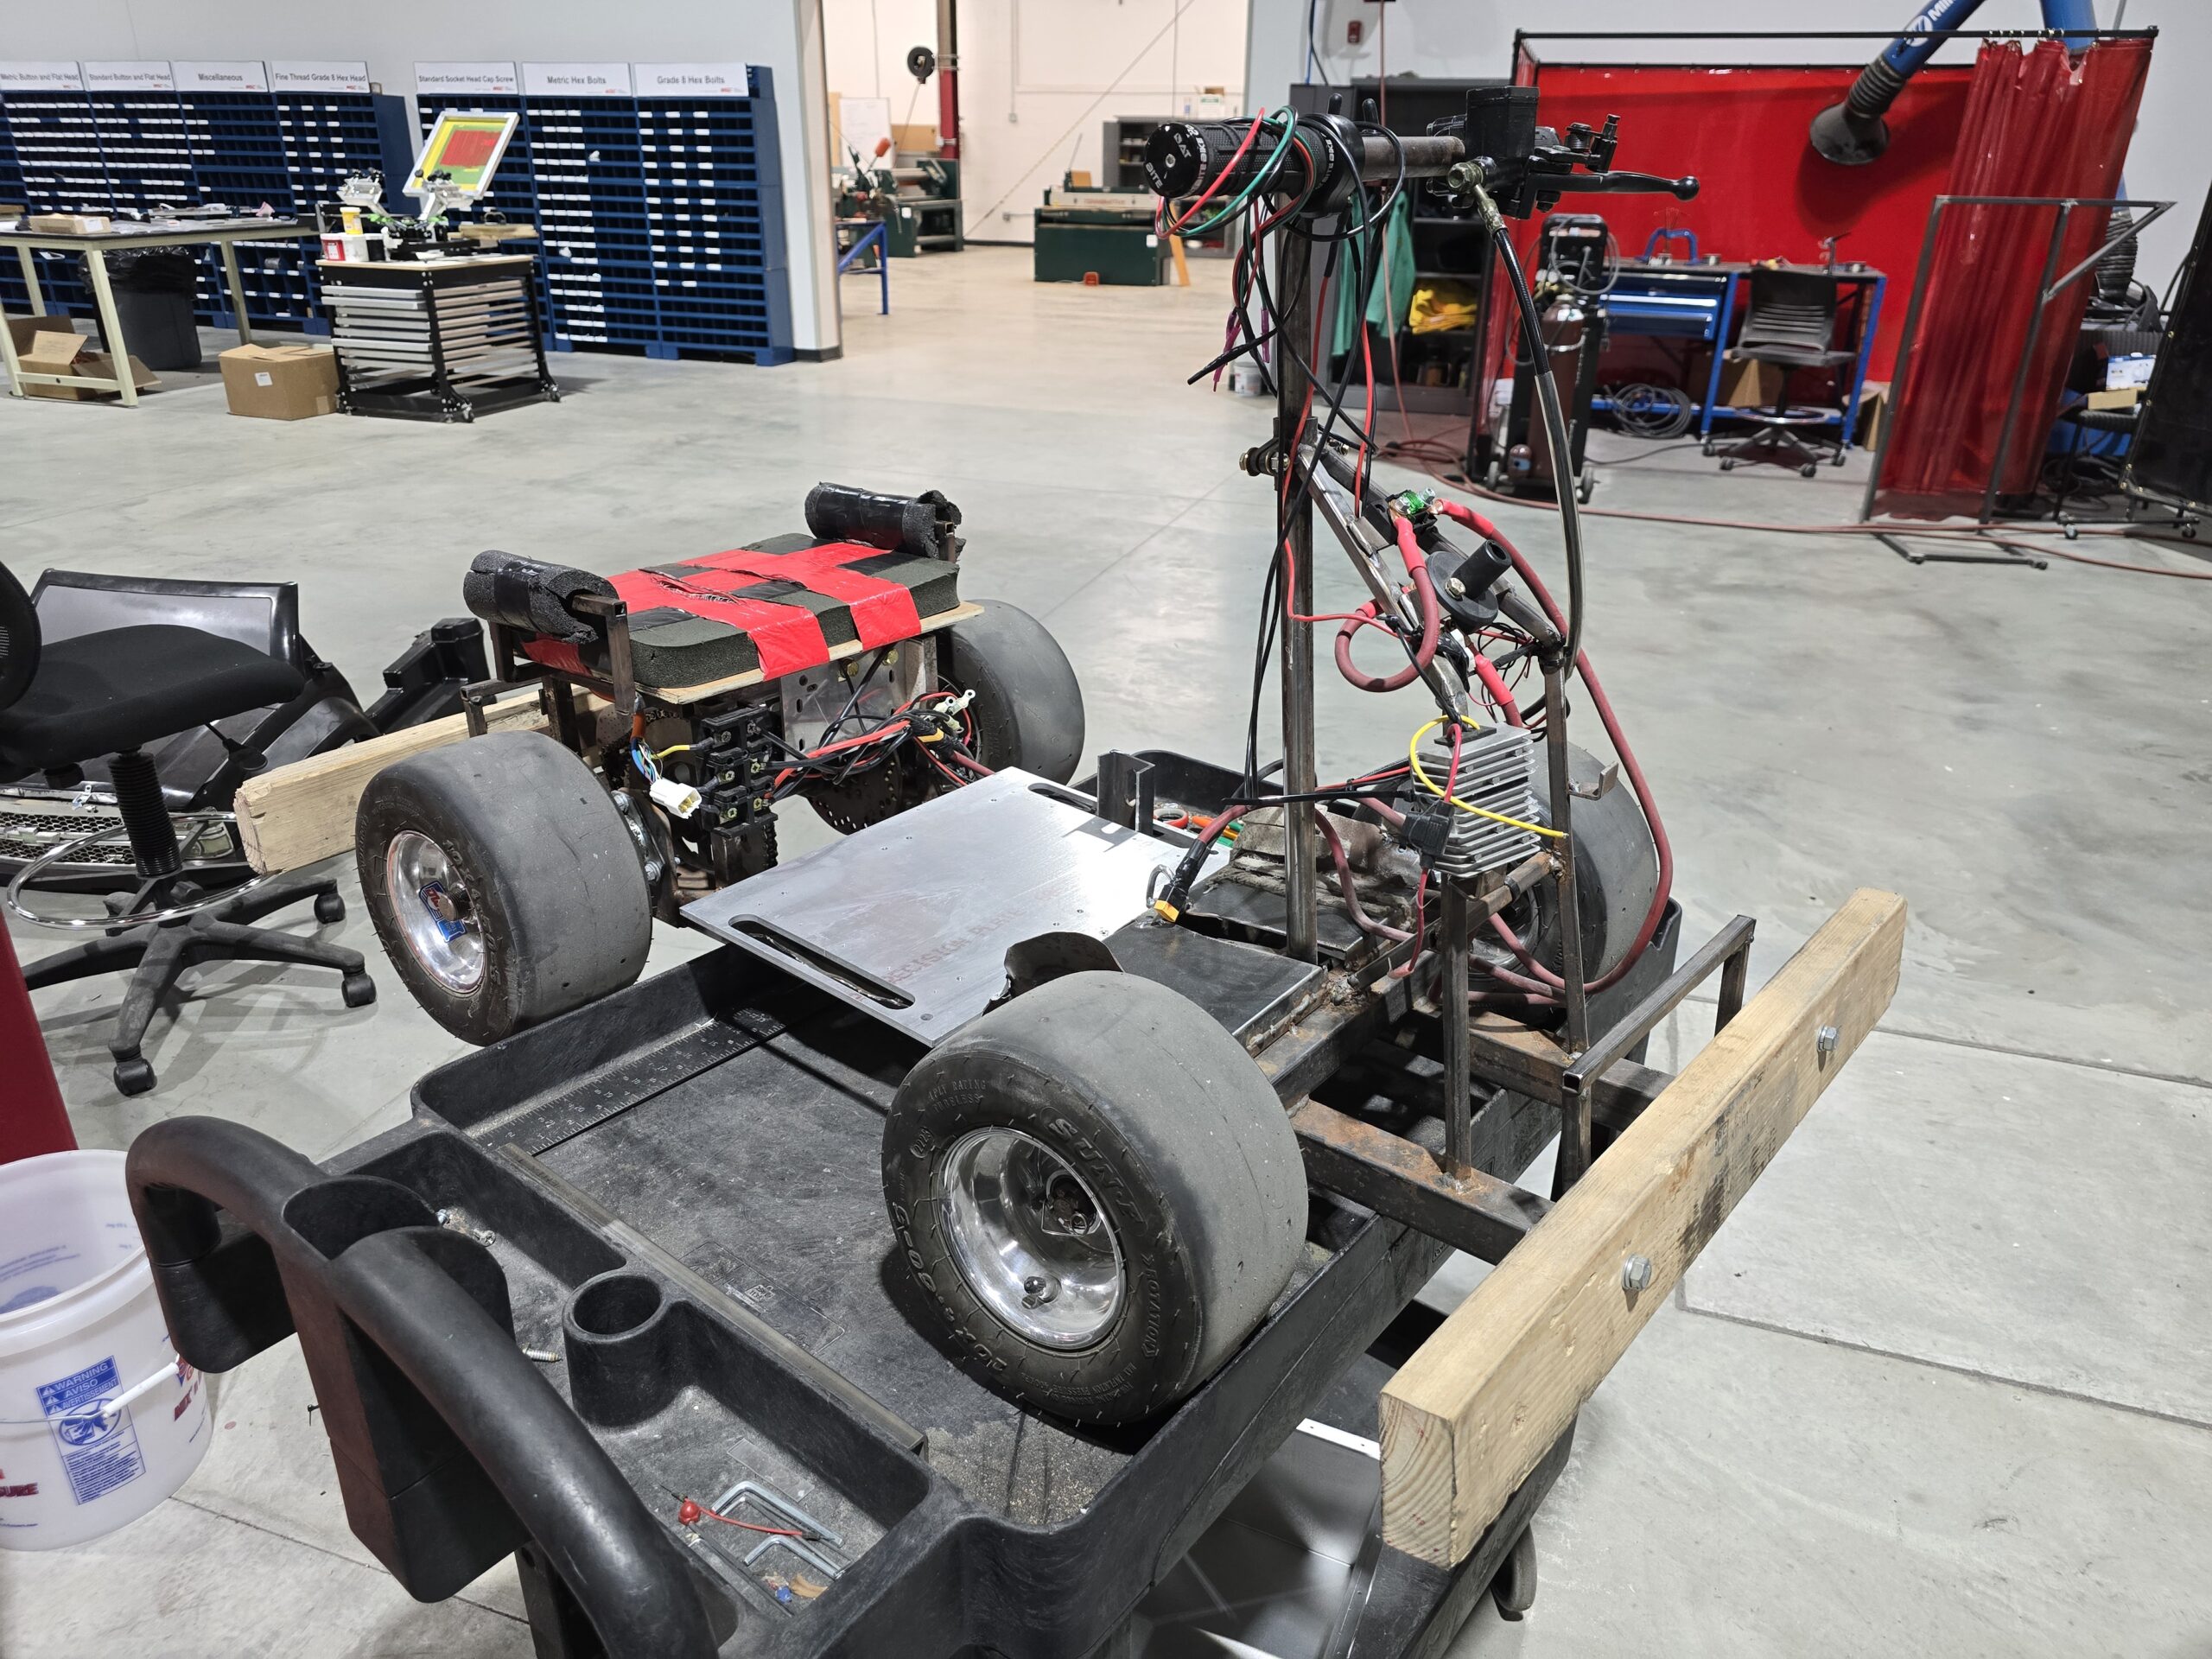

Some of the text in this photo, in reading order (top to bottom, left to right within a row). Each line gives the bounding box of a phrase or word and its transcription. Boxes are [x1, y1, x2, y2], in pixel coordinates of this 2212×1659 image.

[198, 73, 243, 81] Miscellaneous
[275, 73, 289, 81] Fine
[289, 73, 310, 81] Thread
[482, 75, 494, 84] Cap
[547, 75, 569, 84] Metric
[588, 75, 607, 84] Bolts
[657, 75, 680, 84] Grade
[681, 75, 686, 84] 8
[705, 75, 725, 84] Bolts
[952, 1079, 987, 1092] RATING
[932, 1093, 980, 1113] TUBELESS
[1145, 1268, 1160, 1349] ROTATION
[54, 1363, 108, 1390] WARNING
[61, 1378, 118, 1409] AVERTISSEMENT
[63, 1378, 99, 1398] AVISO
